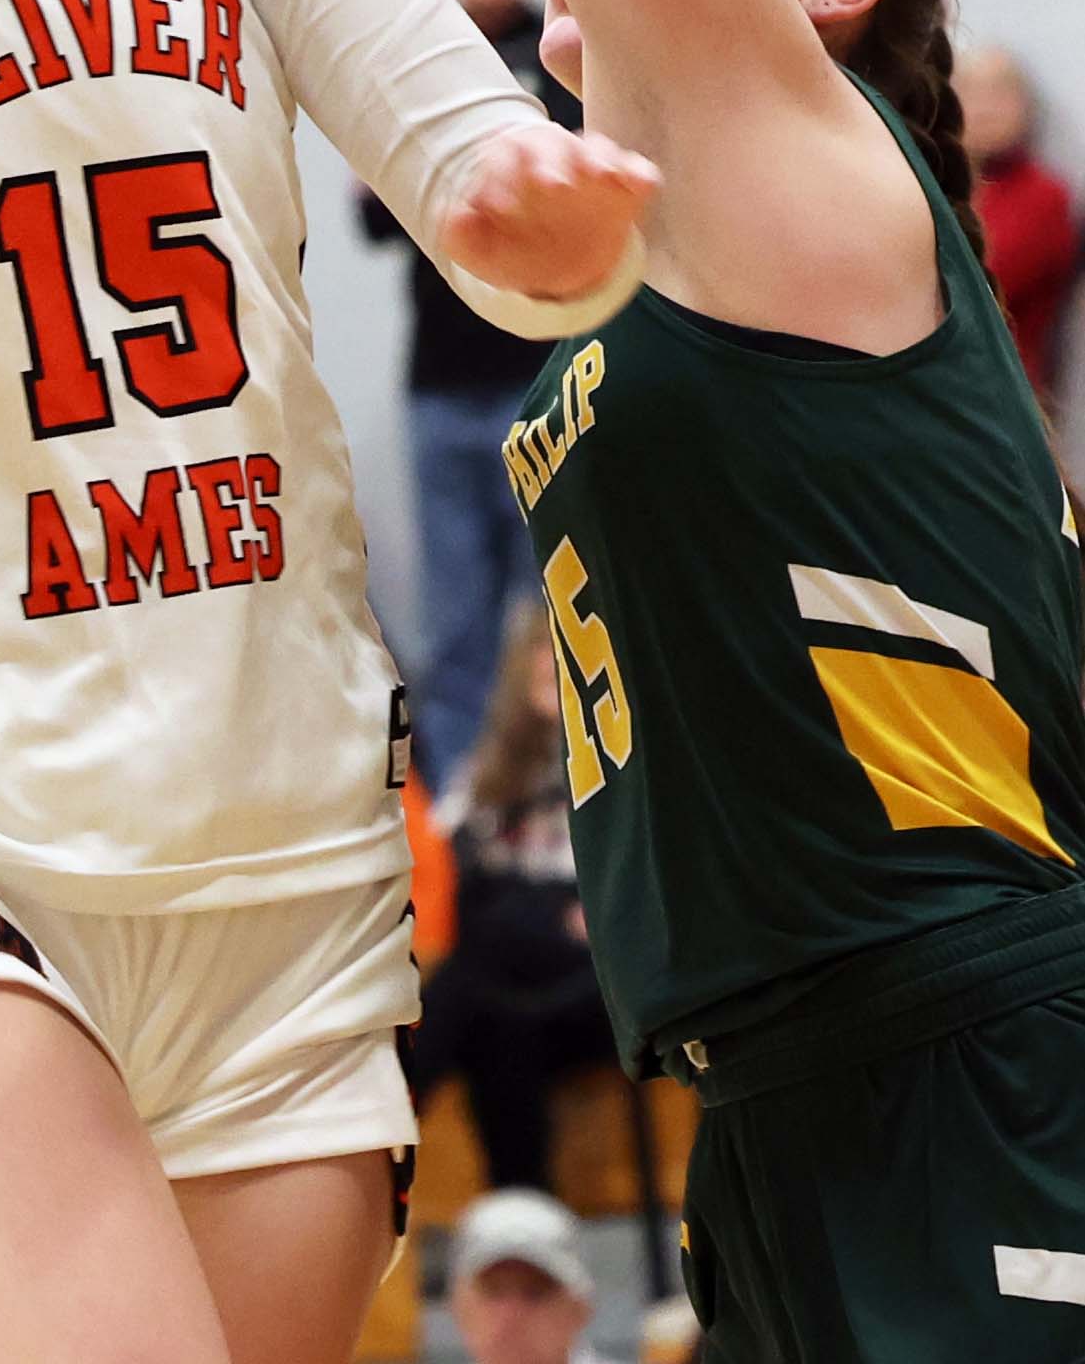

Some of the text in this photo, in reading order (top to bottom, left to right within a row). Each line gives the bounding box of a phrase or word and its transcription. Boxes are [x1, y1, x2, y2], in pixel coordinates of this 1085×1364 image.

[502, 339, 605, 524] HILIP
[20, 453, 285, 620] AMES
[543, 534, 632, 810] 15
